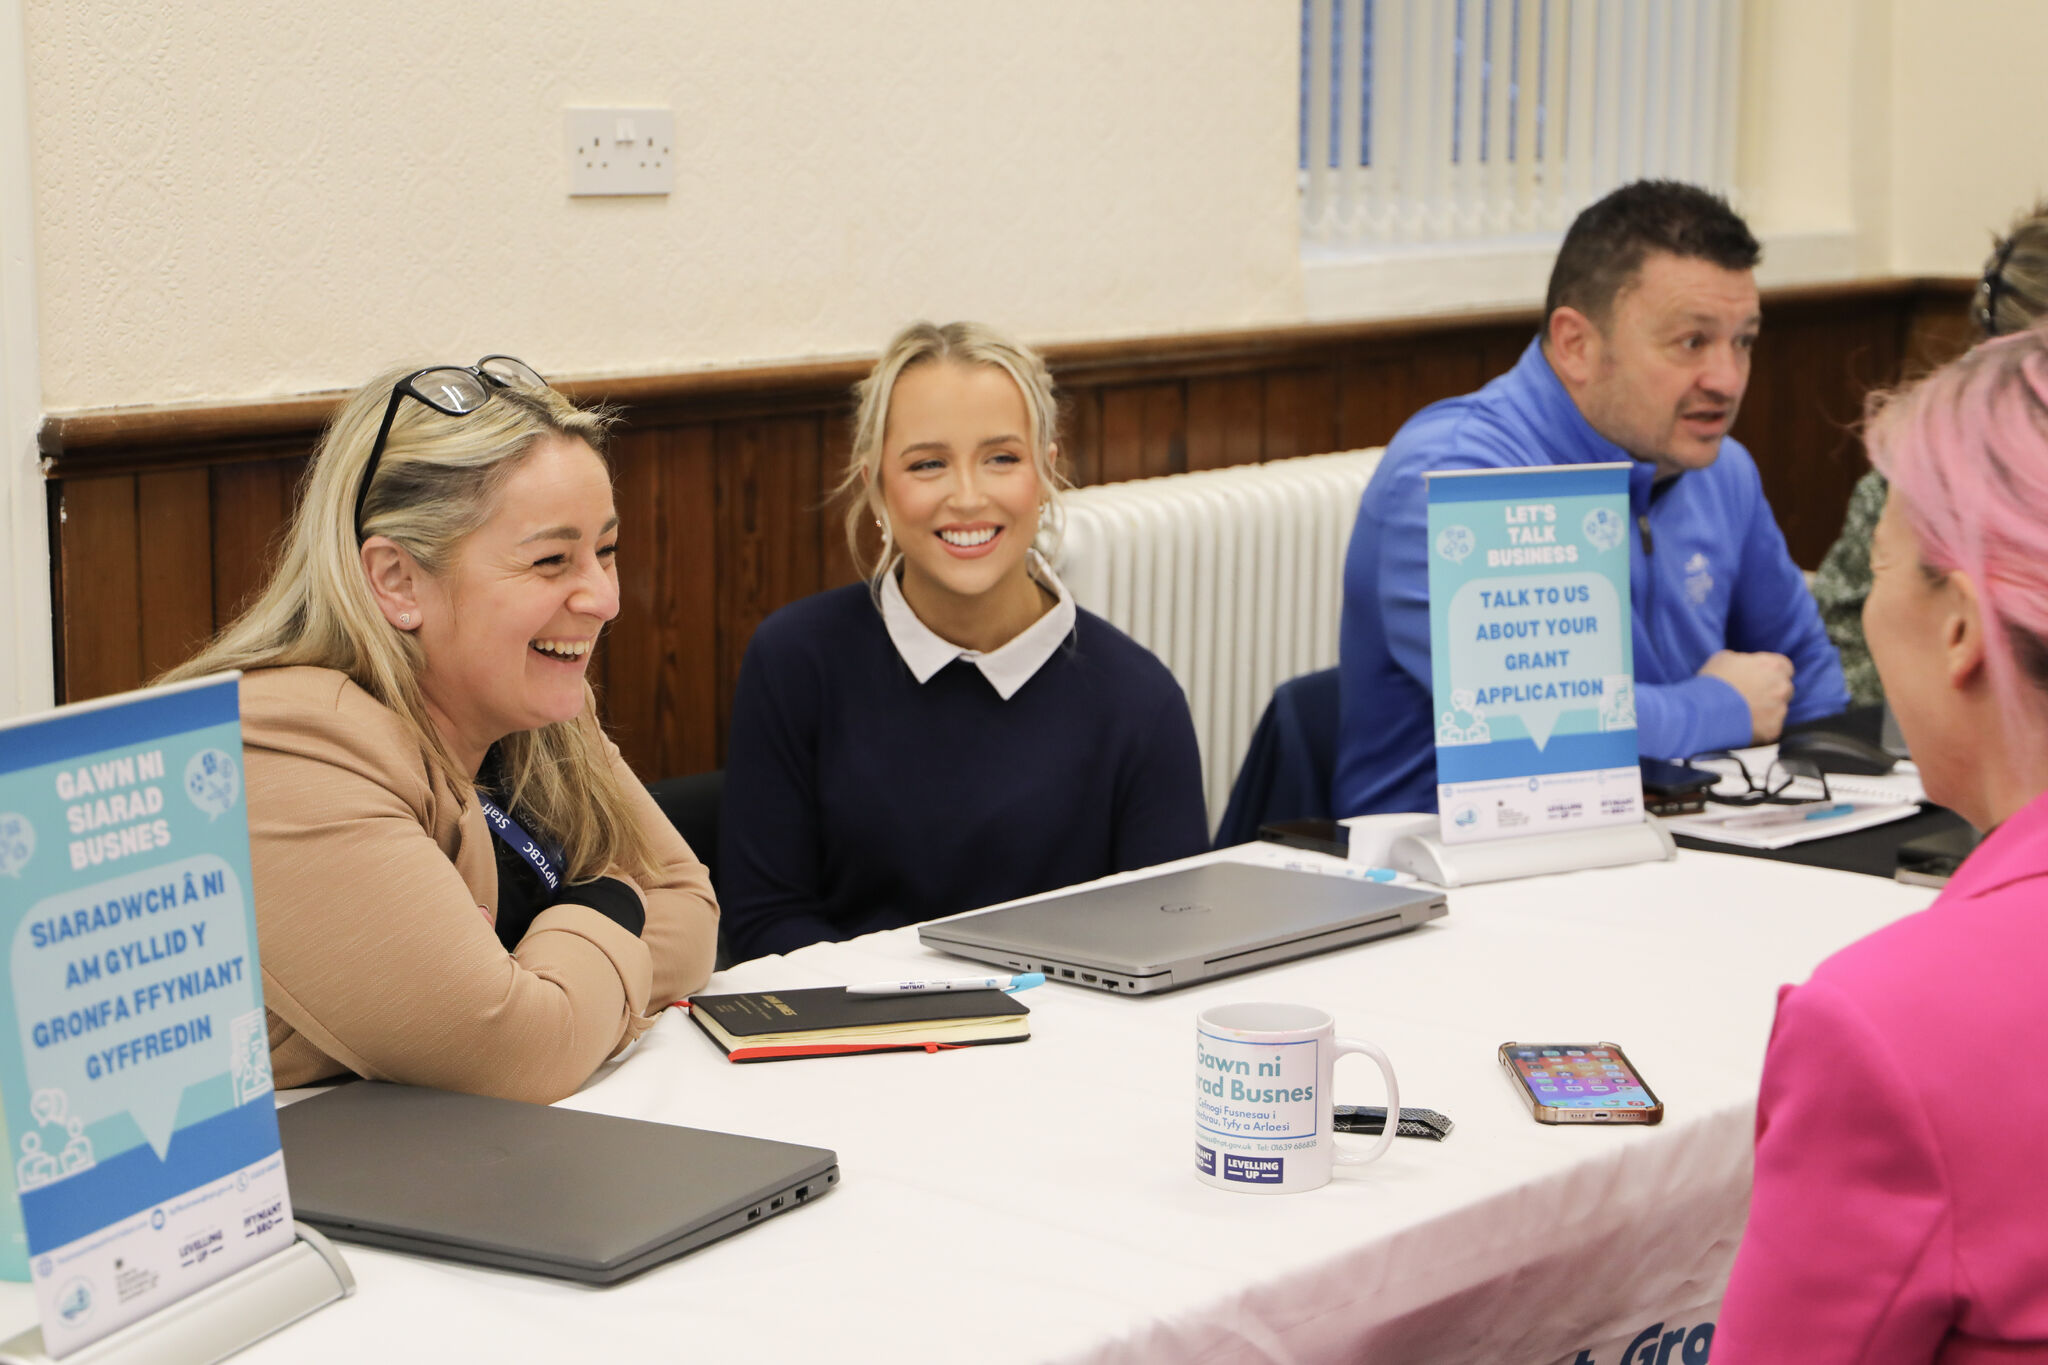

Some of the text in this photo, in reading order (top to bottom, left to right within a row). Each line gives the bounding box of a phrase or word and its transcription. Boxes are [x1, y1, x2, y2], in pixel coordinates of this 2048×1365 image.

[1505, 504, 1557, 524] LET'S
[1508, 525, 1556, 545] TALK
[1487, 544, 1579, 567] BUSINESS
[1480, 585, 1590, 608] TALK TO US
[1476, 616, 1598, 641] ABOUT YOUR
[1505, 650, 1569, 671] GRANT
[1475, 678, 1603, 706] APPLICATION
[56, 750, 165, 801] GAWN NI
[66, 786, 164, 834] SIARAD
[69, 819, 171, 870] BUSNES
[523, 842, 558, 889] NPTCBC
[30, 870, 225, 949] SIARADWCH Â NI
[65, 922, 207, 990] AM GYLLID Y
[33, 957, 244, 1049] GRONFA FFYNIANT
[85, 1014, 213, 1081] GYFFREDIN
[1197, 1042, 1280, 1077] Gawn ni
[1196, 1072, 1313, 1104] rad Busnes
[1222, 1117, 1241, 1131] Tyfy
[1243, 1122, 1250, 1131] a
[1253, 1121, 1290, 1132] Arloesi
[1224, 1105, 1270, 1120] Fusnesau
[1227, 1158, 1279, 1171] LEVELLING
[1245, 1170, 1260, 1180] UP
